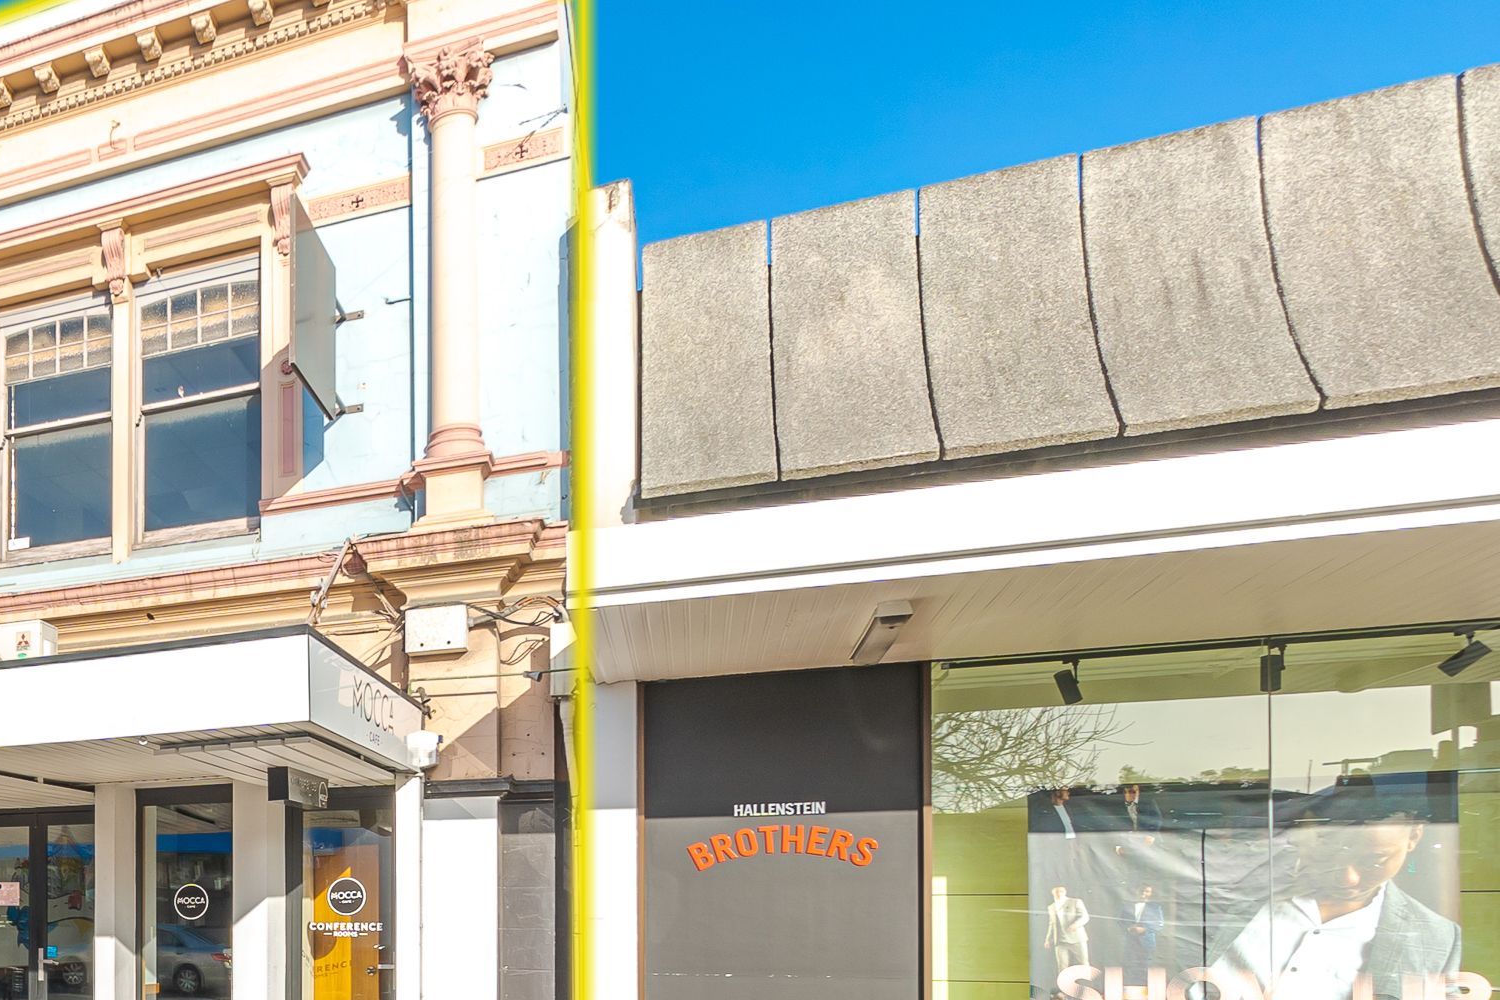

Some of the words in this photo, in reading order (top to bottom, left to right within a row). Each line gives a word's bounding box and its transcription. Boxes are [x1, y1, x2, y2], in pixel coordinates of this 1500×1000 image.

[352, 674, 394, 736] MOCCA
[734, 801, 826, 817] HALLENSTEIN
[686, 824, 879, 872] BROTHERS
[330, 890, 362, 900] MOCCA
[309, 922, 383, 931] CONFERENCE
